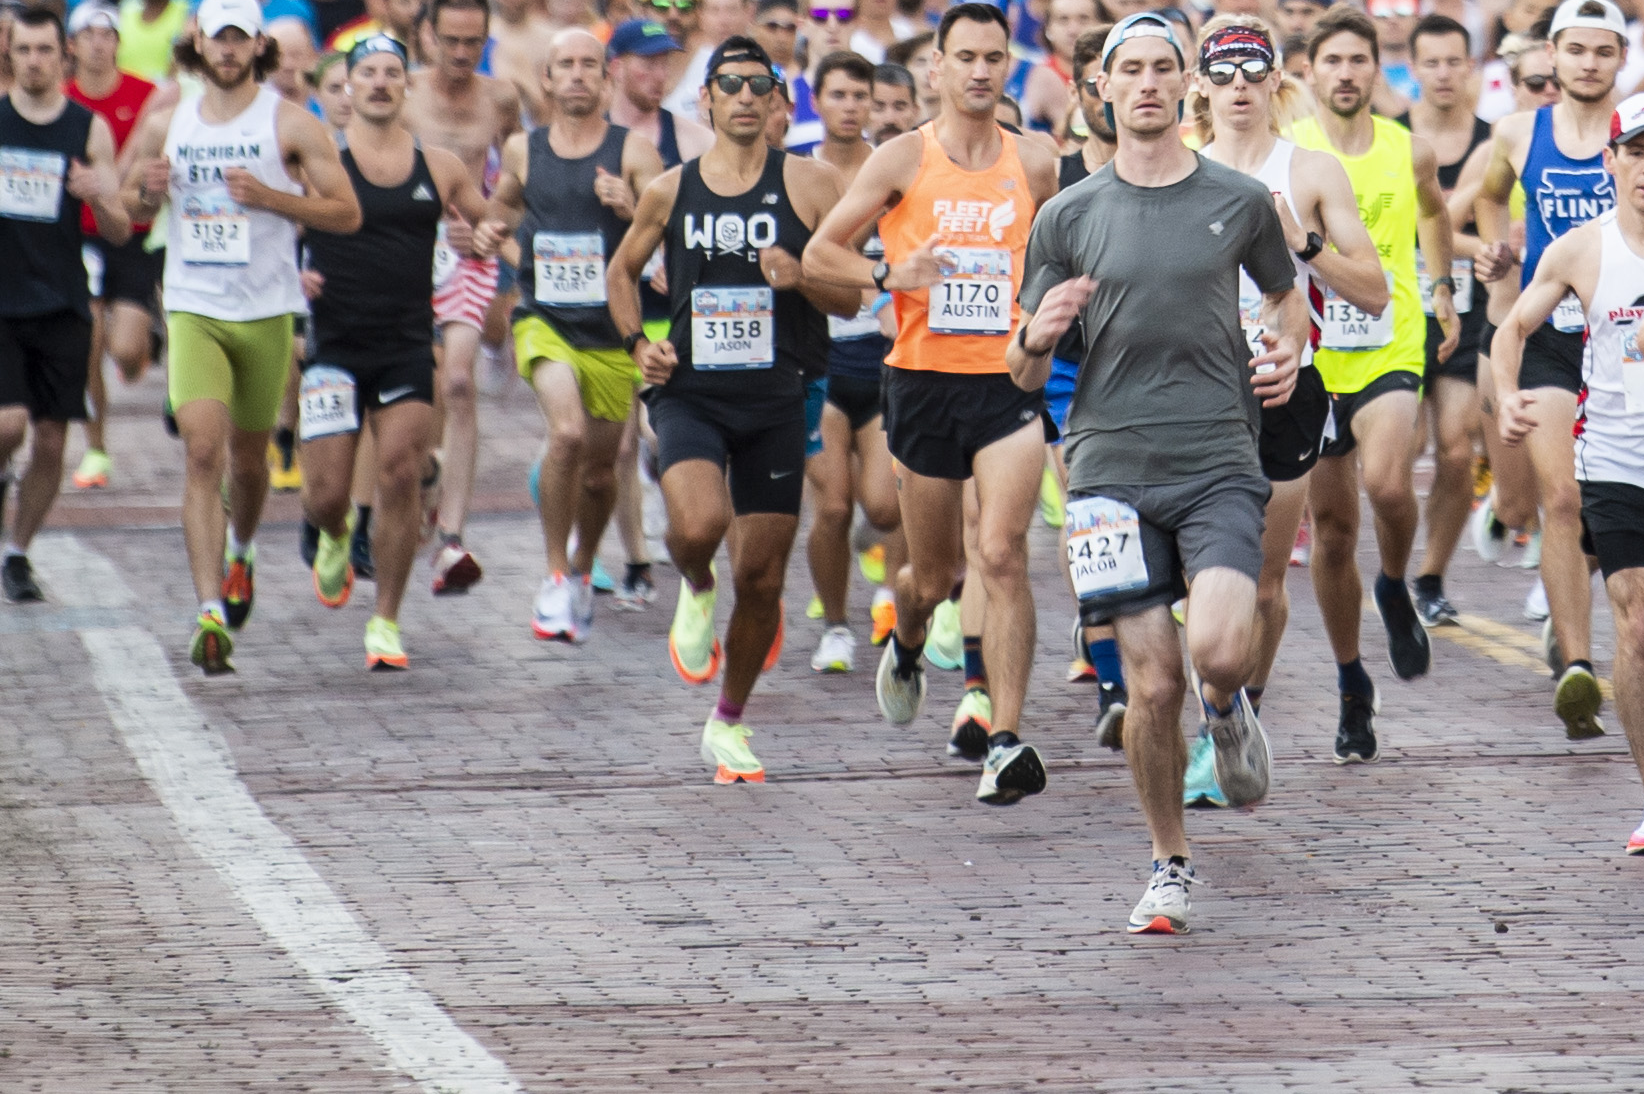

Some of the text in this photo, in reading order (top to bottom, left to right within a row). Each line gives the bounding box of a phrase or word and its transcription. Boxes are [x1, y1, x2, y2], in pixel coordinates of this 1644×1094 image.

[177, 143, 261, 161] MICHIGAN
[188, 164, 246, 183] STA
[933, 200, 993, 217] FLEET
[1542, 198, 1613, 219] FLINT
[191, 222, 239, 241] 3192
[938, 217, 987, 233] FEET
[542, 263, 597, 282] 3256
[943, 283, 999, 303] 1170
[942, 304, 999, 318] AUSTIN
[705, 320, 761, 339] 3158
[1342, 323, 1369, 335] IAN
[714, 340, 752, 354] JASON
[1067, 532, 1129, 566] 2427
[1075, 558, 1117, 579] JACOB
